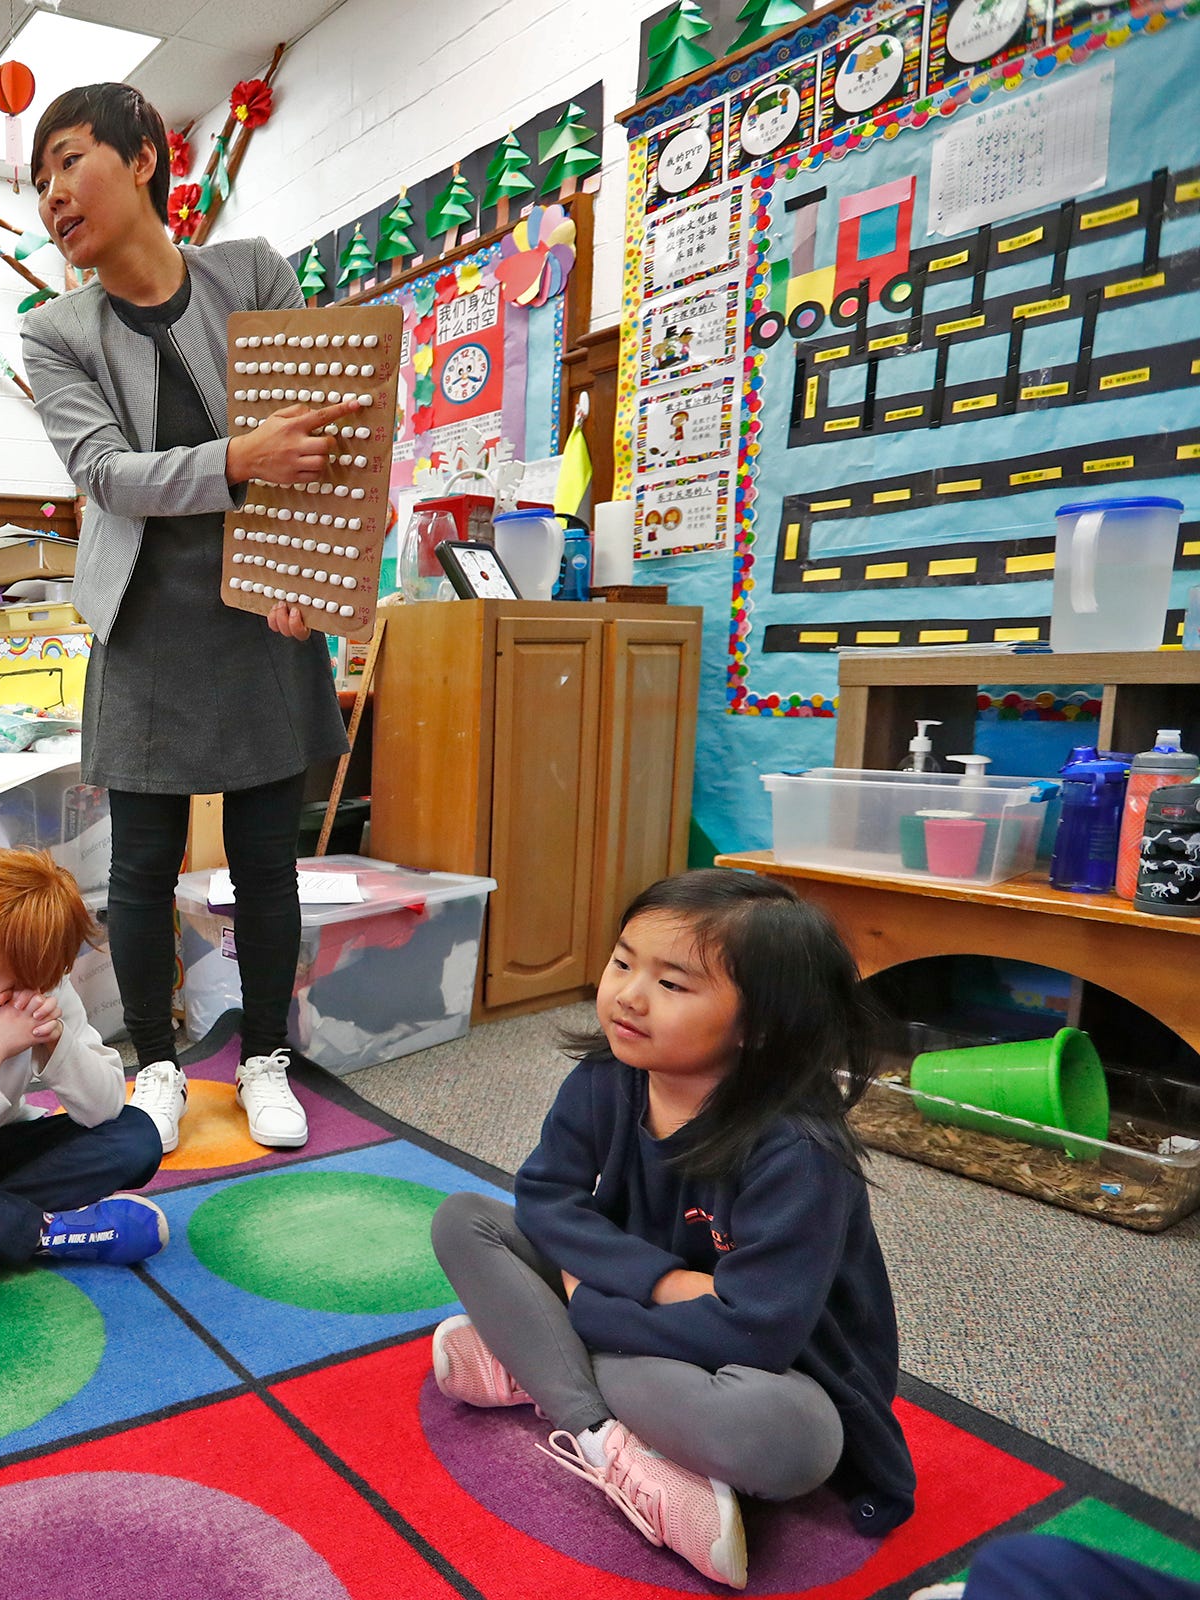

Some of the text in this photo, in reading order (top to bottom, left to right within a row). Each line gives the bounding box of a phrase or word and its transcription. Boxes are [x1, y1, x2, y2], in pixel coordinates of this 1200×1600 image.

[439, 290, 496, 325] 我们身处
[438, 308, 496, 343] 什么时空
[68, 1232, 87, 1244] NIKE
